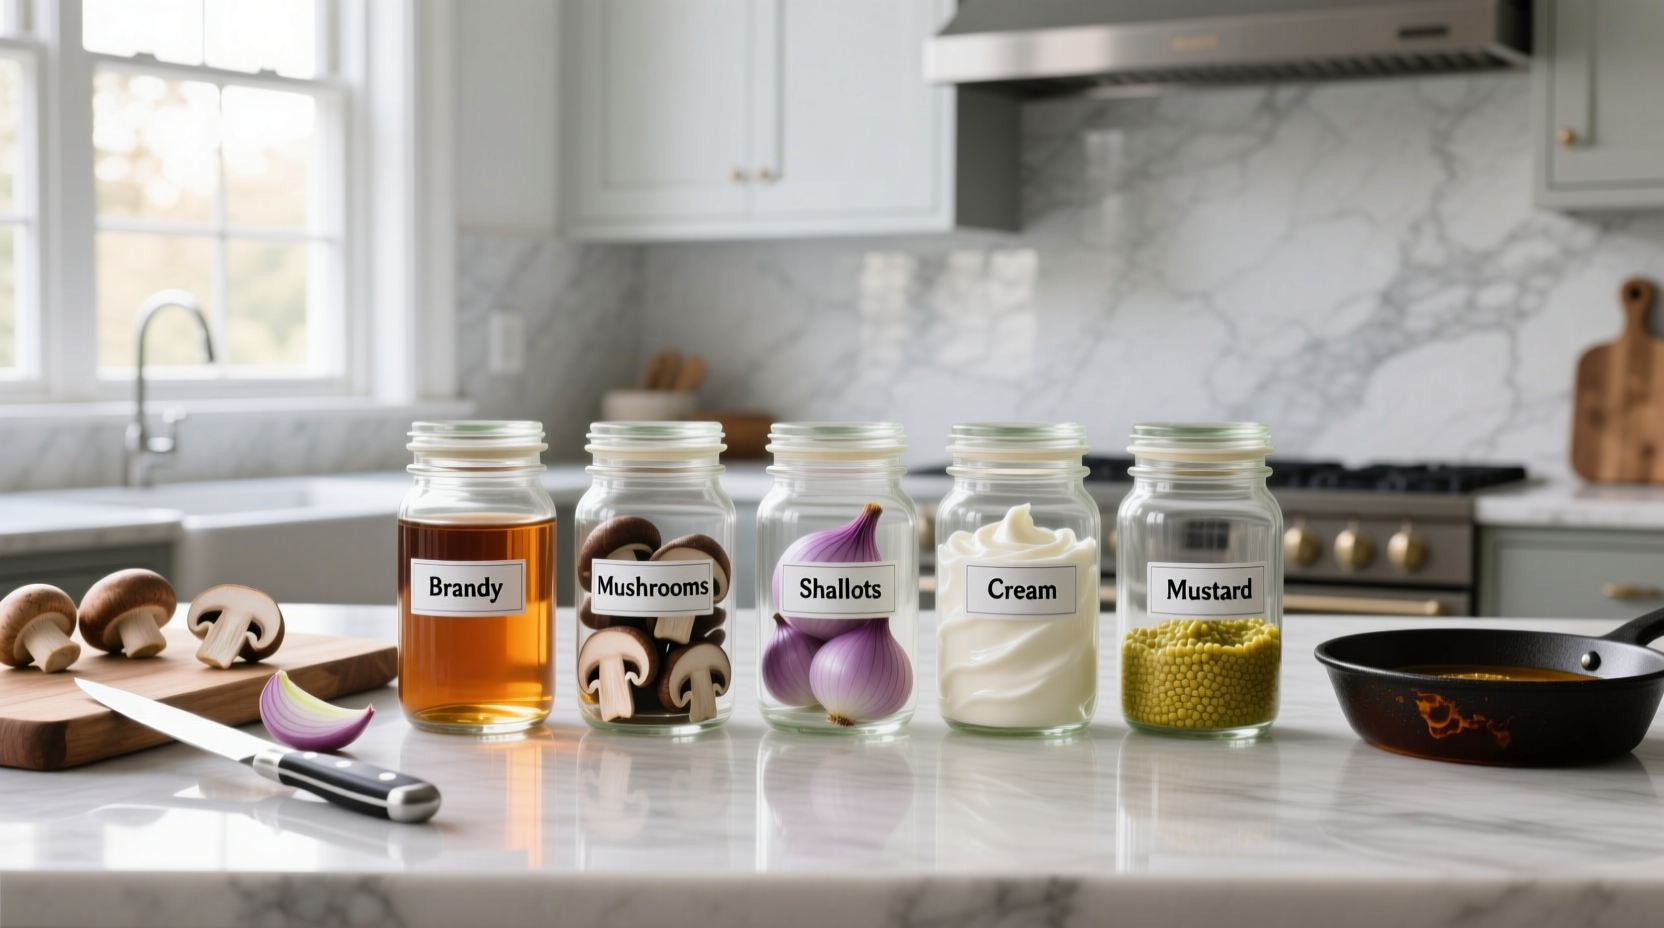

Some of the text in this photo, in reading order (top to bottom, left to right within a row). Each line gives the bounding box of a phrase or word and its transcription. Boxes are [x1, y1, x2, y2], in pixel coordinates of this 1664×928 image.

[429, 576, 504, 604] Brandy
[598, 575, 709, 597] Mushrooms
[799, 577, 882, 600] Shallots
[987, 577, 1057, 601] Cream
[1166, 577, 1253, 601] Mustard
